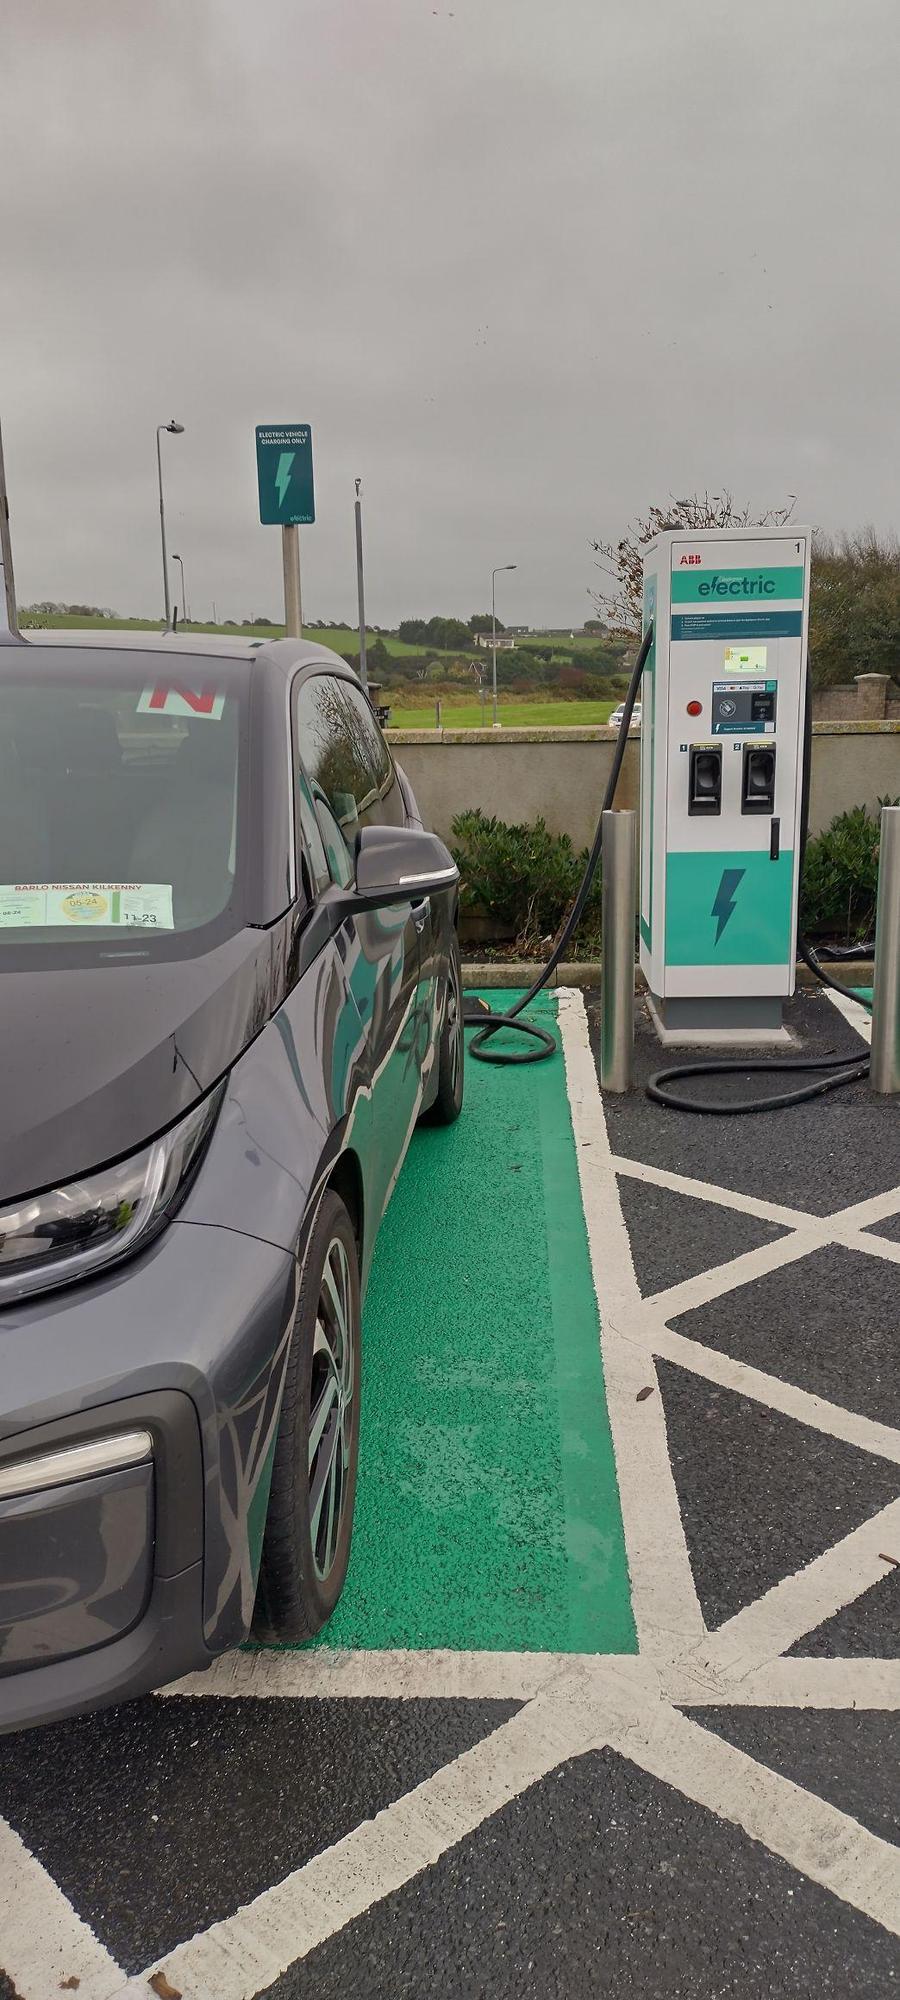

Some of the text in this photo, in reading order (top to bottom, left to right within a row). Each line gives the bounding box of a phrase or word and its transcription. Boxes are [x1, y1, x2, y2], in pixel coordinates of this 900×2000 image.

[794, 542, 800, 553] 1
[680, 555, 702, 565] ABB
[149, 677, 216, 713] N
